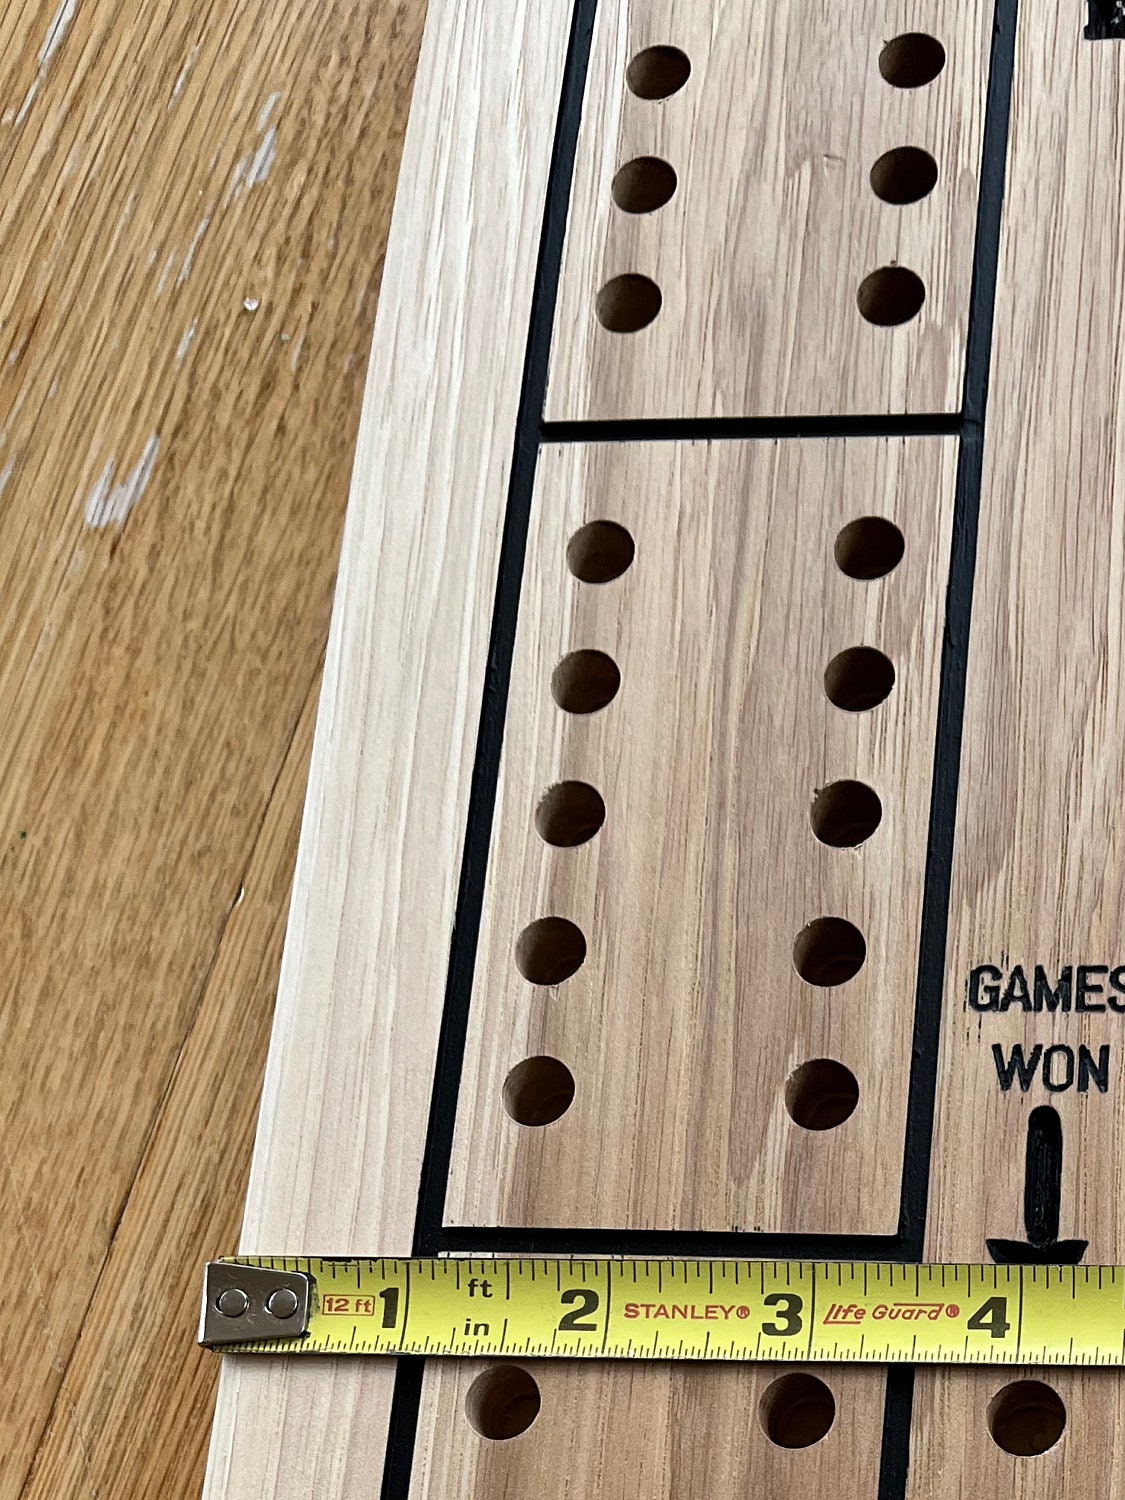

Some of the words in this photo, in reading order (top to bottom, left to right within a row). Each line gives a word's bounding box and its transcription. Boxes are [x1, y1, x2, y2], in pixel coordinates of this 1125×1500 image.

[992, 1044, 1110, 1093] WON
[326, 1297, 349, 1312] 12
[355, 1298, 372, 1313] ft
[379, 1287, 399, 1328] 1
[467, 1279, 493, 1298] ft
[464, 1318, 490, 1336] in
[558, 1289, 599, 1331] 2
[761, 1293, 803, 1337] 3
[967, 1296, 1011, 1339] 4
